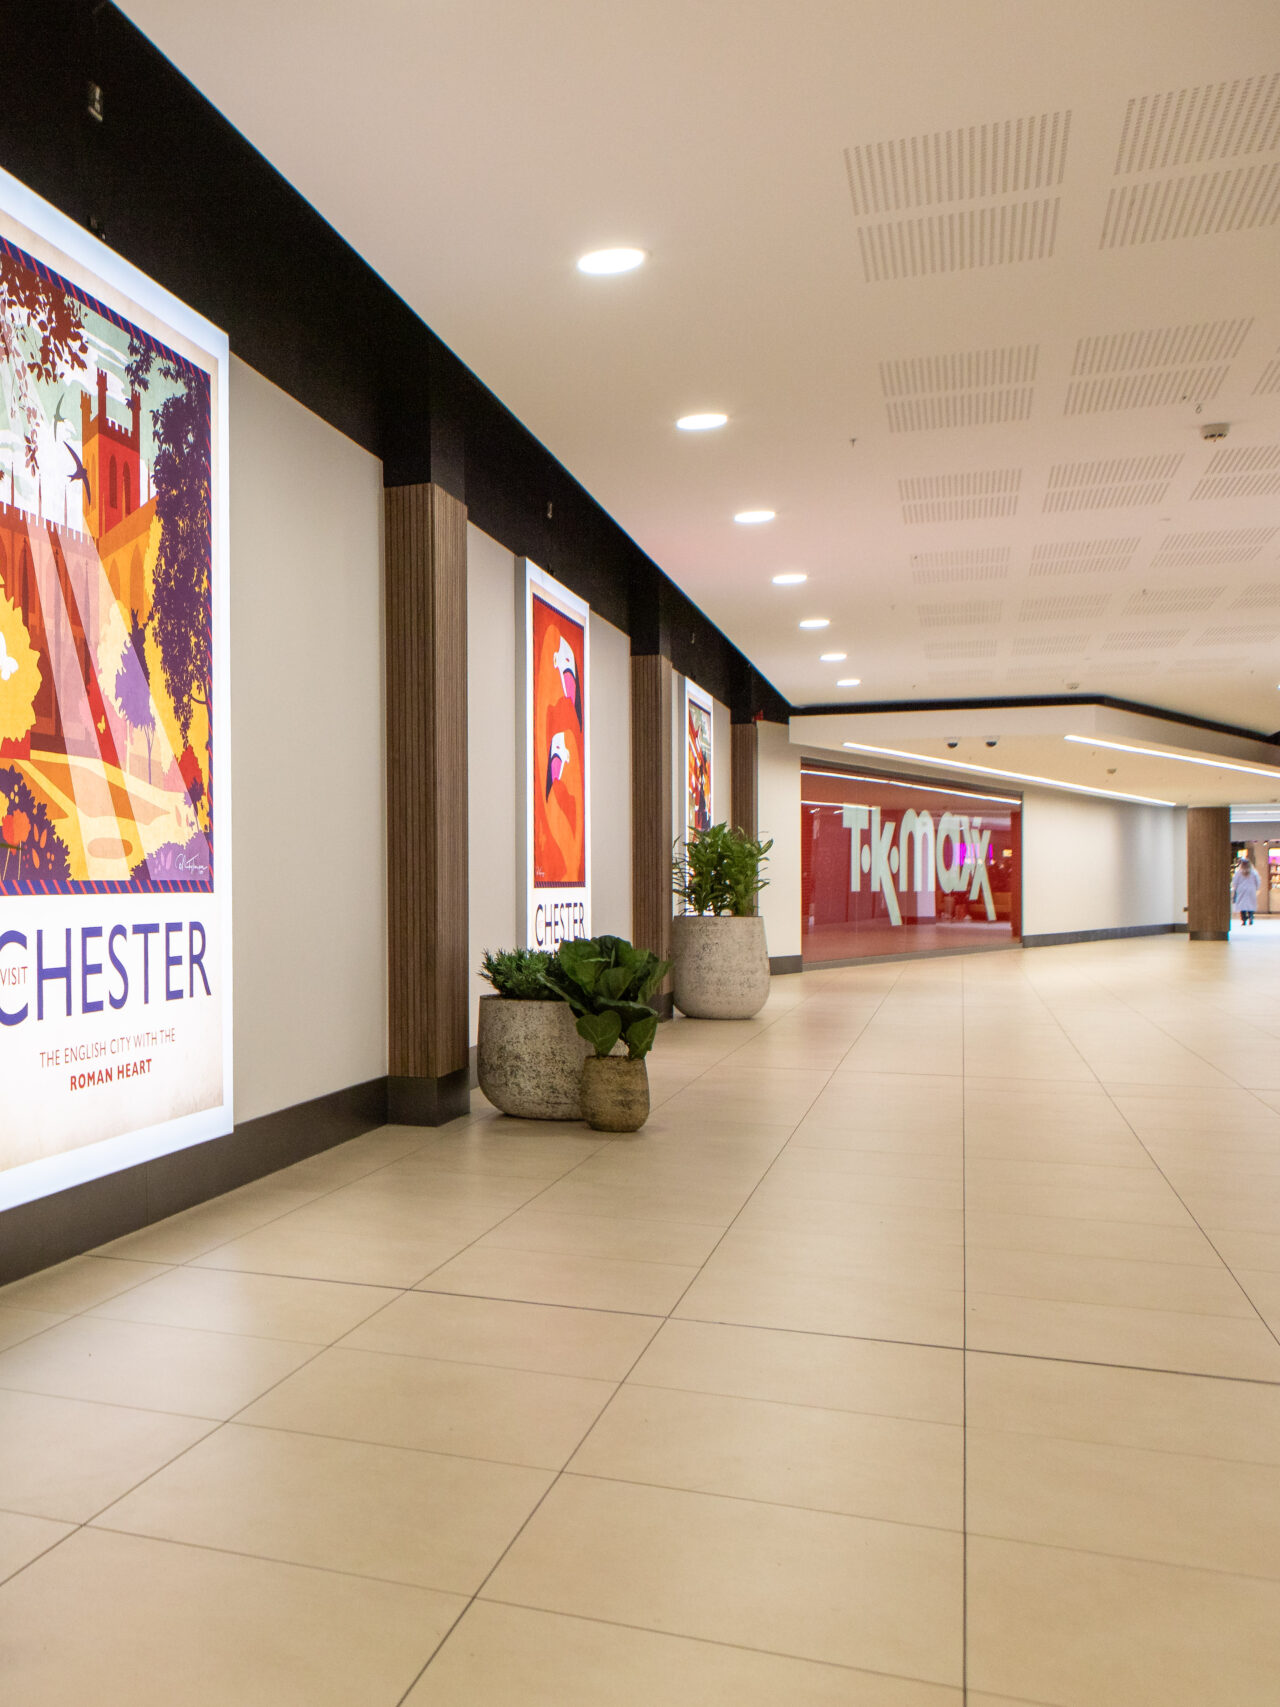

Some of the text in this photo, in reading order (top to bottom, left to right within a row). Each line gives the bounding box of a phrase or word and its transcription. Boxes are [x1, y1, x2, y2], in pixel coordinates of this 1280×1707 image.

[535, 902, 586, 946] CHESTER
[0, 966, 28, 986] VISIT
[40, 1028, 176, 1068] THE ENGLISH CITY WITH THE
[70, 1058, 153, 1091] ROMAN HEART
